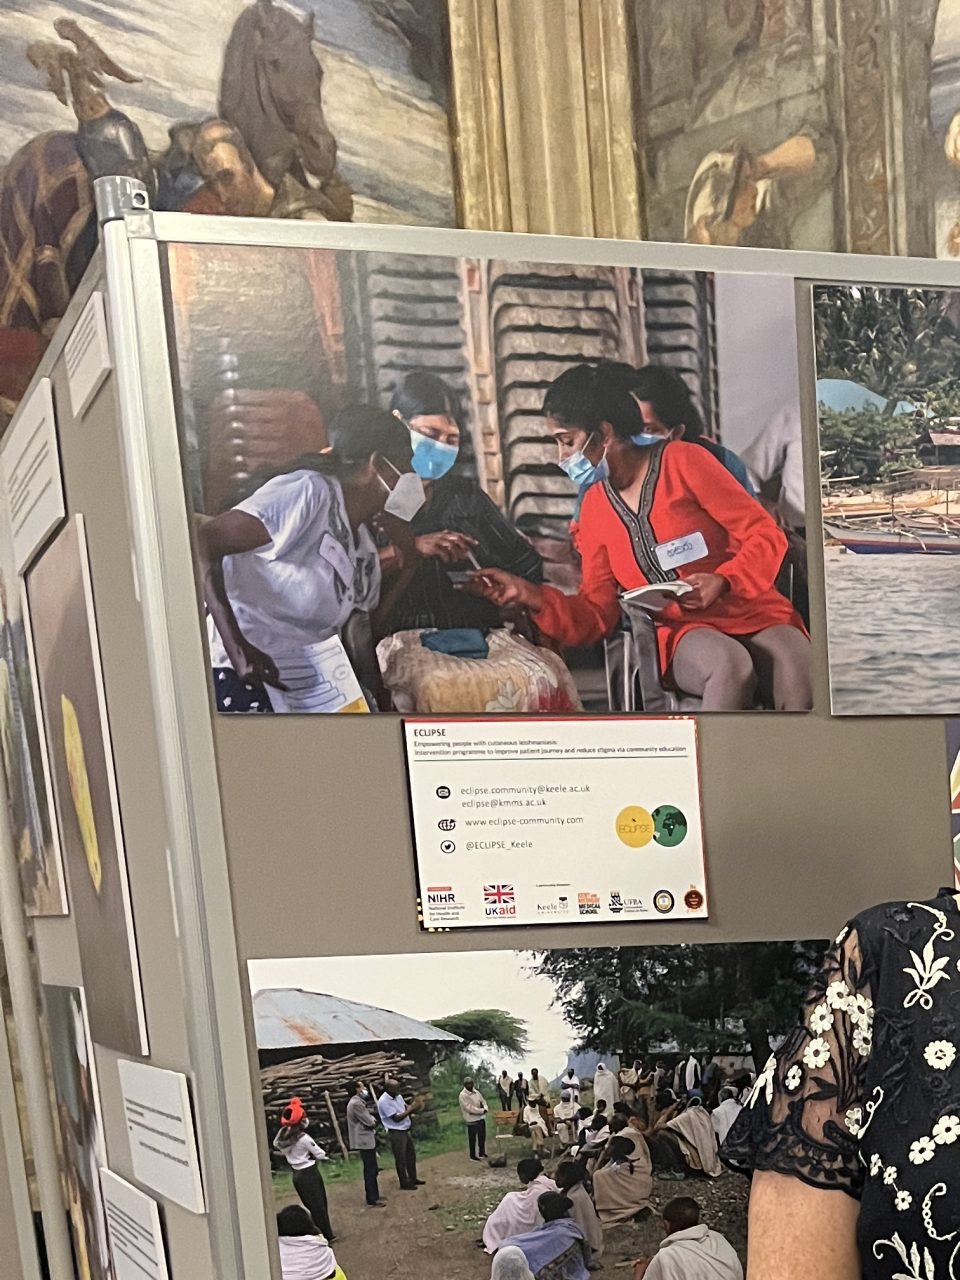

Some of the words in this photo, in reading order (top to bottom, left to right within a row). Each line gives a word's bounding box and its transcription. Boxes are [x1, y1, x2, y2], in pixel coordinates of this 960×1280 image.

[414, 728, 446, 737] ECLIPSE
[541, 747, 563, 755] journey
[597, 746, 615, 754] stigma
[460, 785, 590, 796] eclipse.community@keele.ac.uk
[461, 799, 547, 809] eclipse@kmms.ac.uk
[465, 817, 584, 827] www.eclipse-community.com
[466, 840, 533, 851] @ECLIPSE_Keele
[427, 893, 455, 903] NIHR
